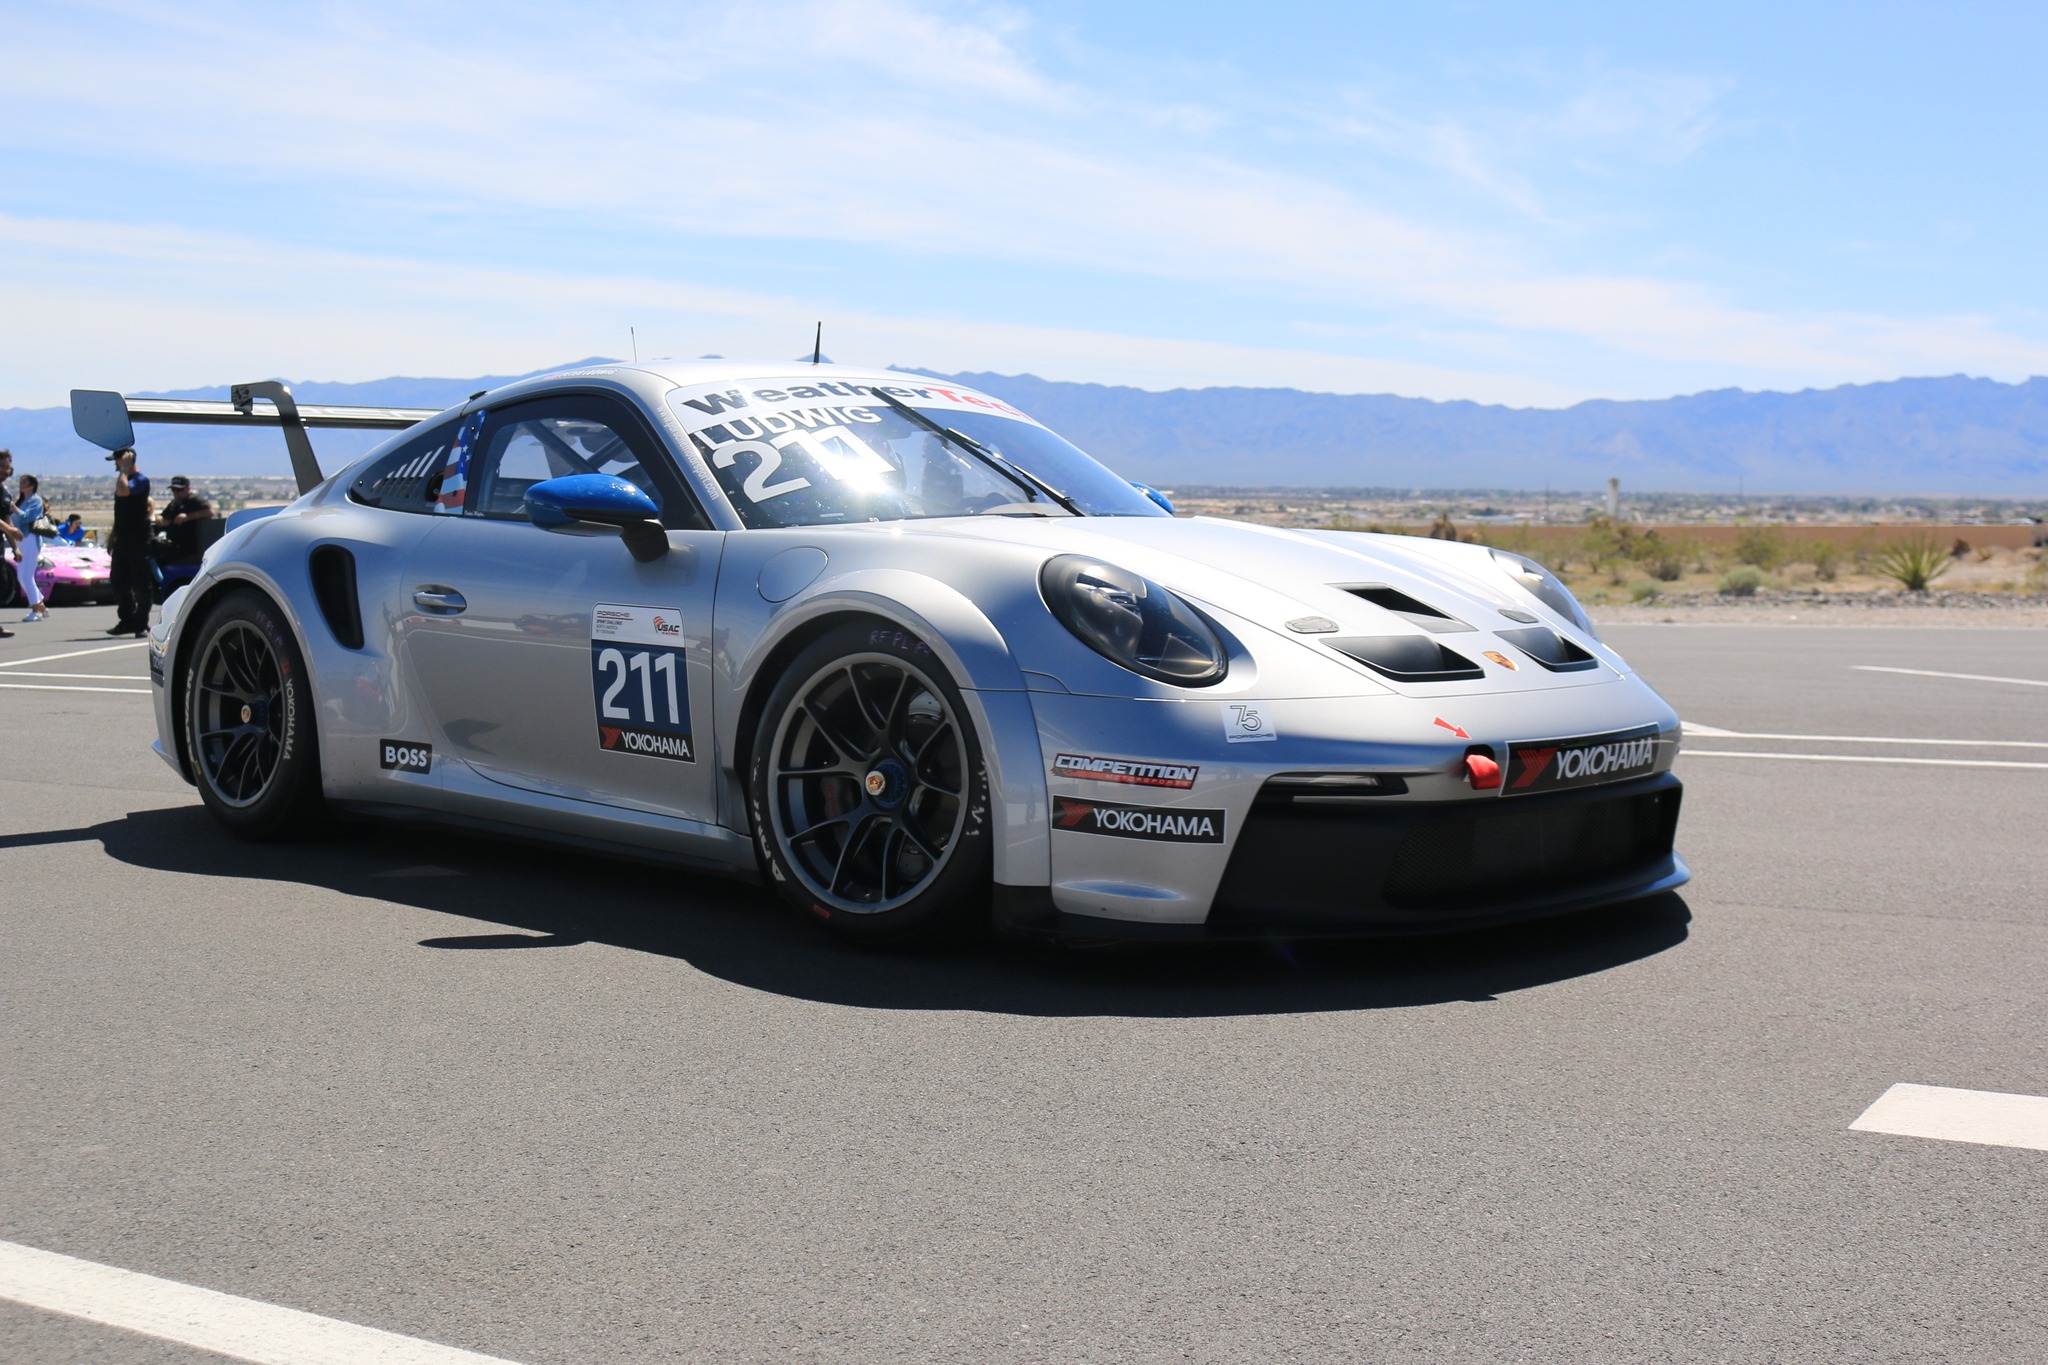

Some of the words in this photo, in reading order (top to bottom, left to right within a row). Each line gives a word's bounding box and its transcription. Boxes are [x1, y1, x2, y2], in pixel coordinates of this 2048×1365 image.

[681, 381, 1034, 422] WeatherTec
[693, 406, 882, 450] LUDWIG
[657, 624, 680, 633] USAC
[598, 648, 680, 725] 211
[283, 678, 296, 760] YOKOHAMA
[1230, 705, 1262, 731] 75
[621, 731, 690, 757] YOKOHAMA
[1228, 732, 1275, 741] PORSCHE
[385, 746, 427, 767] BOSS
[1055, 755, 1198, 781] COMPETITION
[1556, 737, 1652, 778] YOKOHAMA
[1093, 808, 1215, 836] YOKOHAMA
